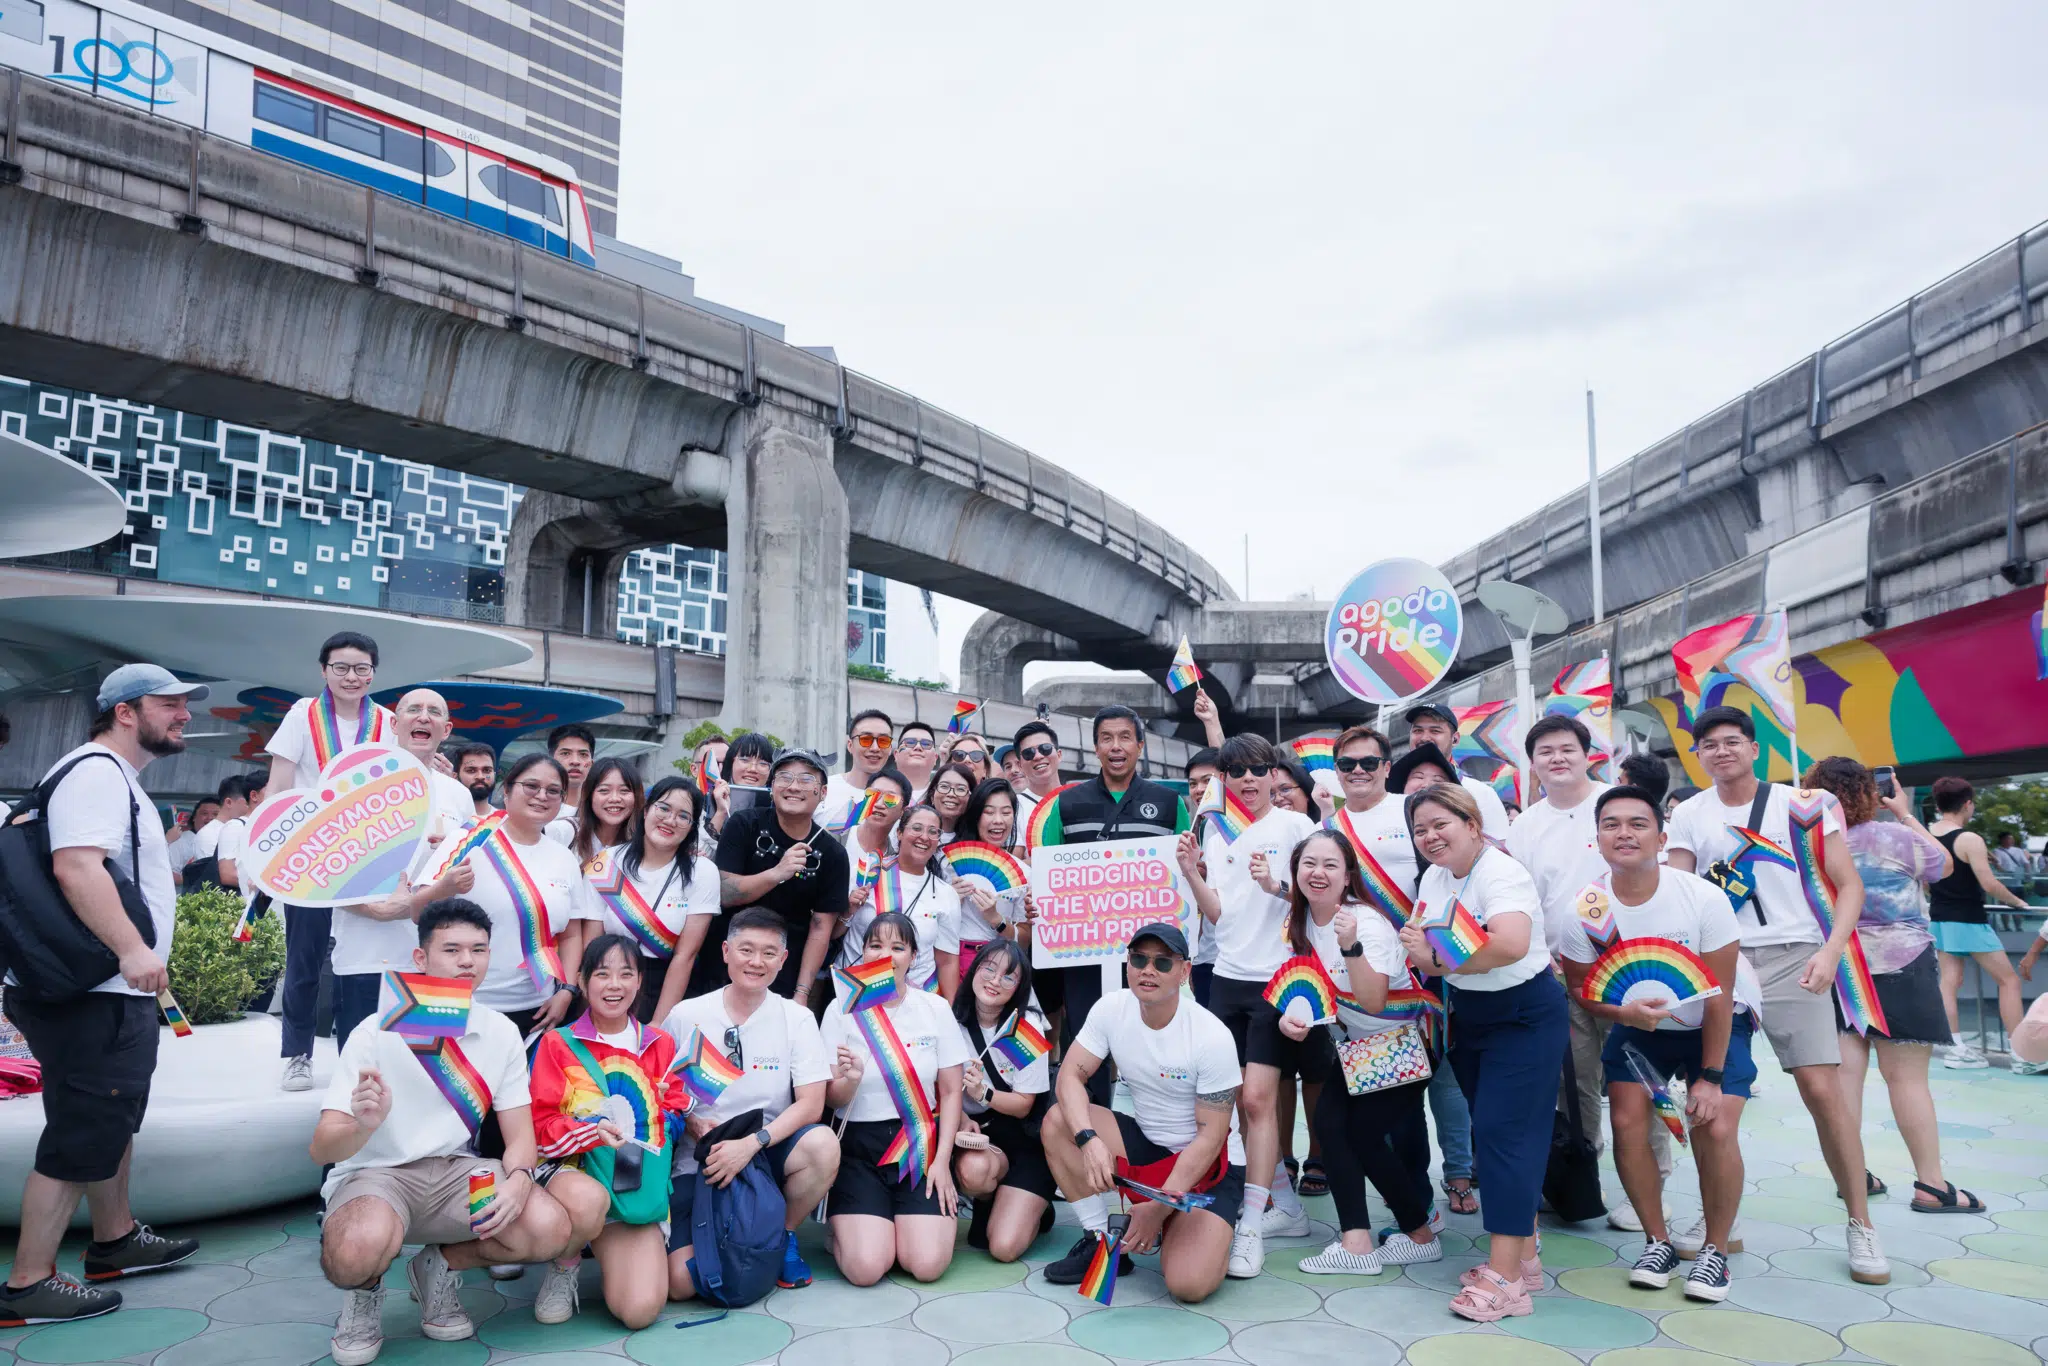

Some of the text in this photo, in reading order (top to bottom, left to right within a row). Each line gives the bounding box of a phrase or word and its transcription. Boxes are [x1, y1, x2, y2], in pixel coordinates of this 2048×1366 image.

[49, 34, 173, 86] 100
[1339, 586, 1448, 628] agoda
[1332, 618, 1443, 661] Pride
[258, 801, 319, 852] agoda
[271, 777, 425, 893] HONEYMOON
[308, 810, 416, 888] FOR ALL
[1053, 849, 1100, 864] agoda
[1050, 861, 1164, 889] BRIDGING
[1038, 888, 1175, 917] THE WORLD
[1381, 891, 1395, 904] the
[1038, 921, 1099, 943] WITH
[753, 1052, 780, 1064] agoda
[1159, 1064, 1186, 1074] agoda
[440, 1056, 471, 1095] agoda
